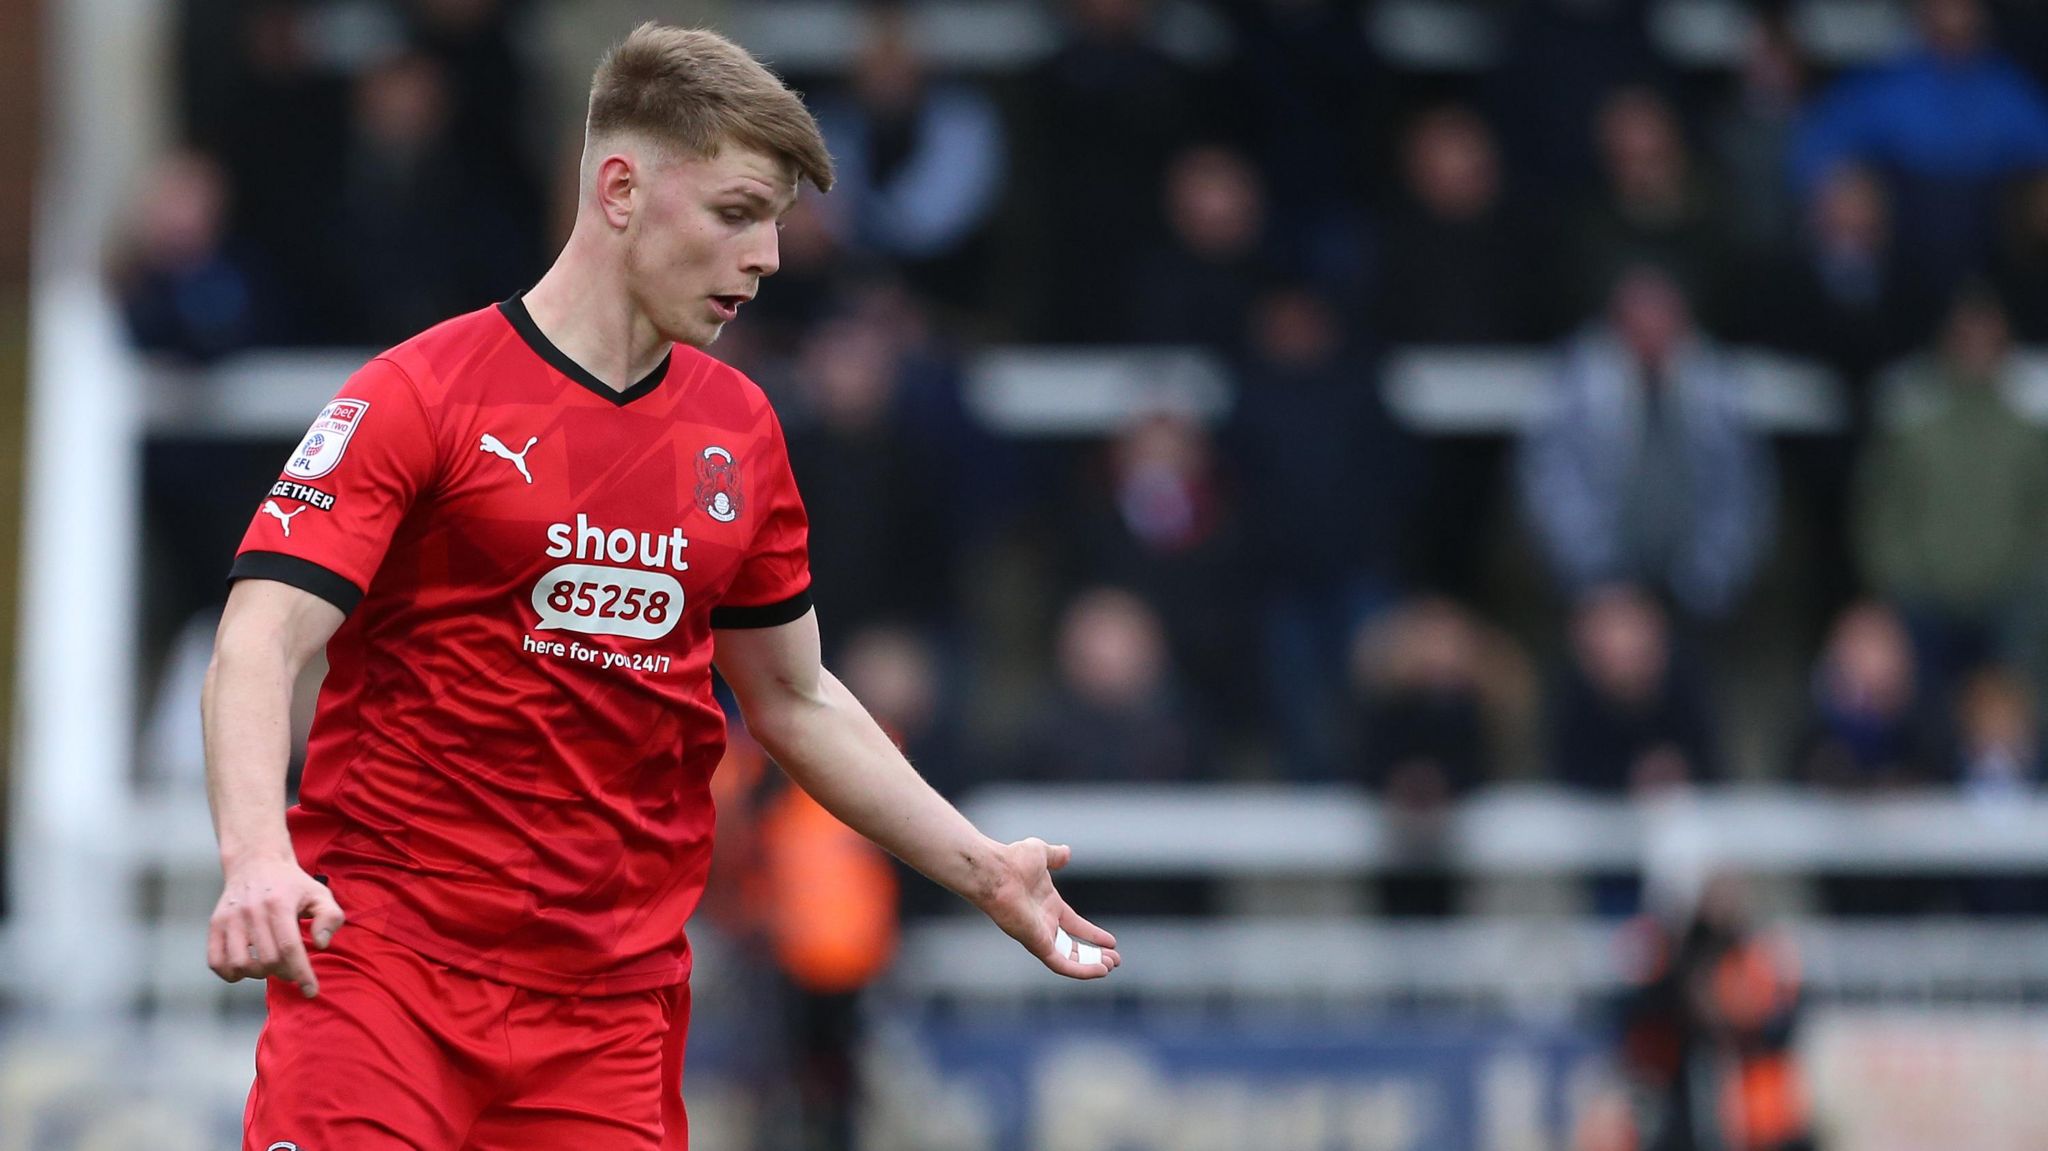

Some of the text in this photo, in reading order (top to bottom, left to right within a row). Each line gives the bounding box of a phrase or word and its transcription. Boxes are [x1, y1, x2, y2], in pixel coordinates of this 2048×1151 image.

[333, 405, 355, 419] bet
[332, 421, 348, 432] TWO
[293, 457, 311, 471] EFL
[545, 513, 689, 571] shout
[547, 580, 670, 625] 85258
[523, 634, 670, 673] here for you 24/7
